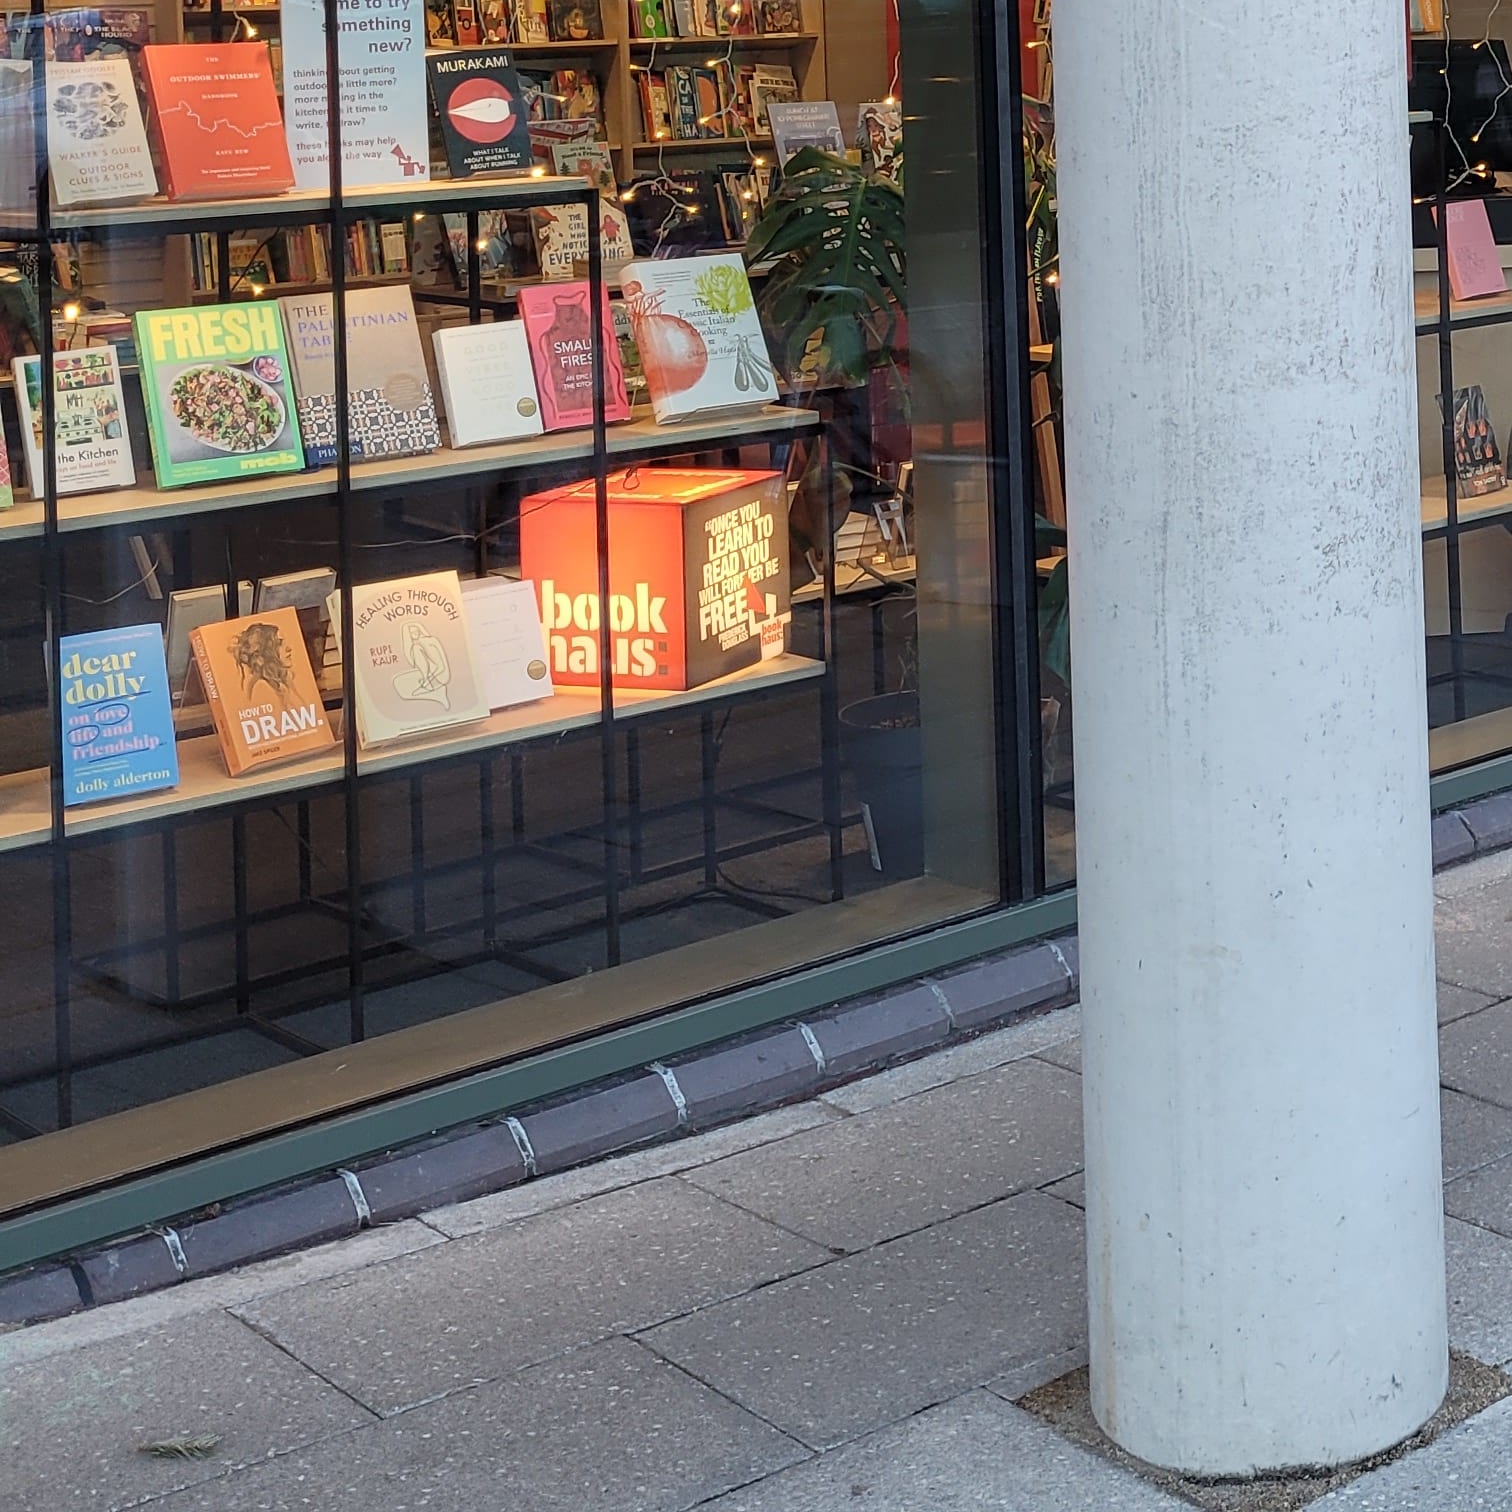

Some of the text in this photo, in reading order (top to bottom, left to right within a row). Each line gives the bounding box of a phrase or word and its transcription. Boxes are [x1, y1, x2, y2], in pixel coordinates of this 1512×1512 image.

[321, 17, 411, 33] smething
[368, 38, 412, 53] new?
[338, 66, 360, 76] bout
[362, 66, 396, 79] getting
[436, 55, 509, 74] MURAKAMI
[170, 75, 212, 83] OUTDOOR
[293, 78, 397, 91] outdoo little more?
[294, 90, 384, 104] more in the
[346, 105, 353, 114] it
[355, 103, 376, 114] time
[378, 104, 388, 112] to
[111, 146, 142, 156] GUIDE
[296, 136, 397, 150] these may help
[296, 150, 382, 166] you the way
[464, 156, 484, 164] ABOUT
[485, 154, 502, 162] WHEN
[472, 148, 490, 156] WHAT
[495, 147, 509, 155] TALK
[79, 162, 129, 175] OUTDOOR
[470, 160, 518, 171] ABOUT RUNNING
[69, 175, 99, 186] CLUES
[113, 171, 144, 181] SIGNS
[568, 214, 582, 222] THE
[568, 222, 586, 230] GIRL
[562, 240, 589, 250] NOTIC
[549, 246, 626, 266] EVERYING
[692, 298, 711, 308] The
[293, 304, 329, 319] THE
[678, 306, 730, 319] Essentials of
[297, 311, 409, 334] PALTINIAN
[709, 316, 736, 326] Italian
[149, 306, 280, 361] FRESH
[57, 447, 119, 464] the Kitchen
[318, 444, 362, 458] PHAON
[239, 452, 298, 470] mob
[739, 500, 761, 524] YOU
[708, 513, 774, 562] LEARN TO
[702, 538, 769, 588] READ YOU
[698, 557, 779, 607] WILL FOREER BE
[355, 589, 459, 629] HEALING THROUGH
[383, 605, 429, 623] WORDS
[541, 579, 668, 634] book
[699, 588, 749, 641] FREE
[761, 619, 782, 635] book
[761, 631, 783, 646] haus:
[369, 644, 393, 657] RUPI
[62, 650, 137, 679] dear
[372, 654, 400, 667] KAUR
[65, 672, 145, 704] dolly
[205, 670, 219, 700] DRAW
[69, 705, 127, 726] on love
[238, 703, 273, 719] HOW TO
[241, 703, 324, 745] DRAW.
[69, 722, 133, 744] life and
[72, 734, 160, 761] friendship
[75, 777, 109, 795] dolly
[113, 768, 170, 787] alderton
